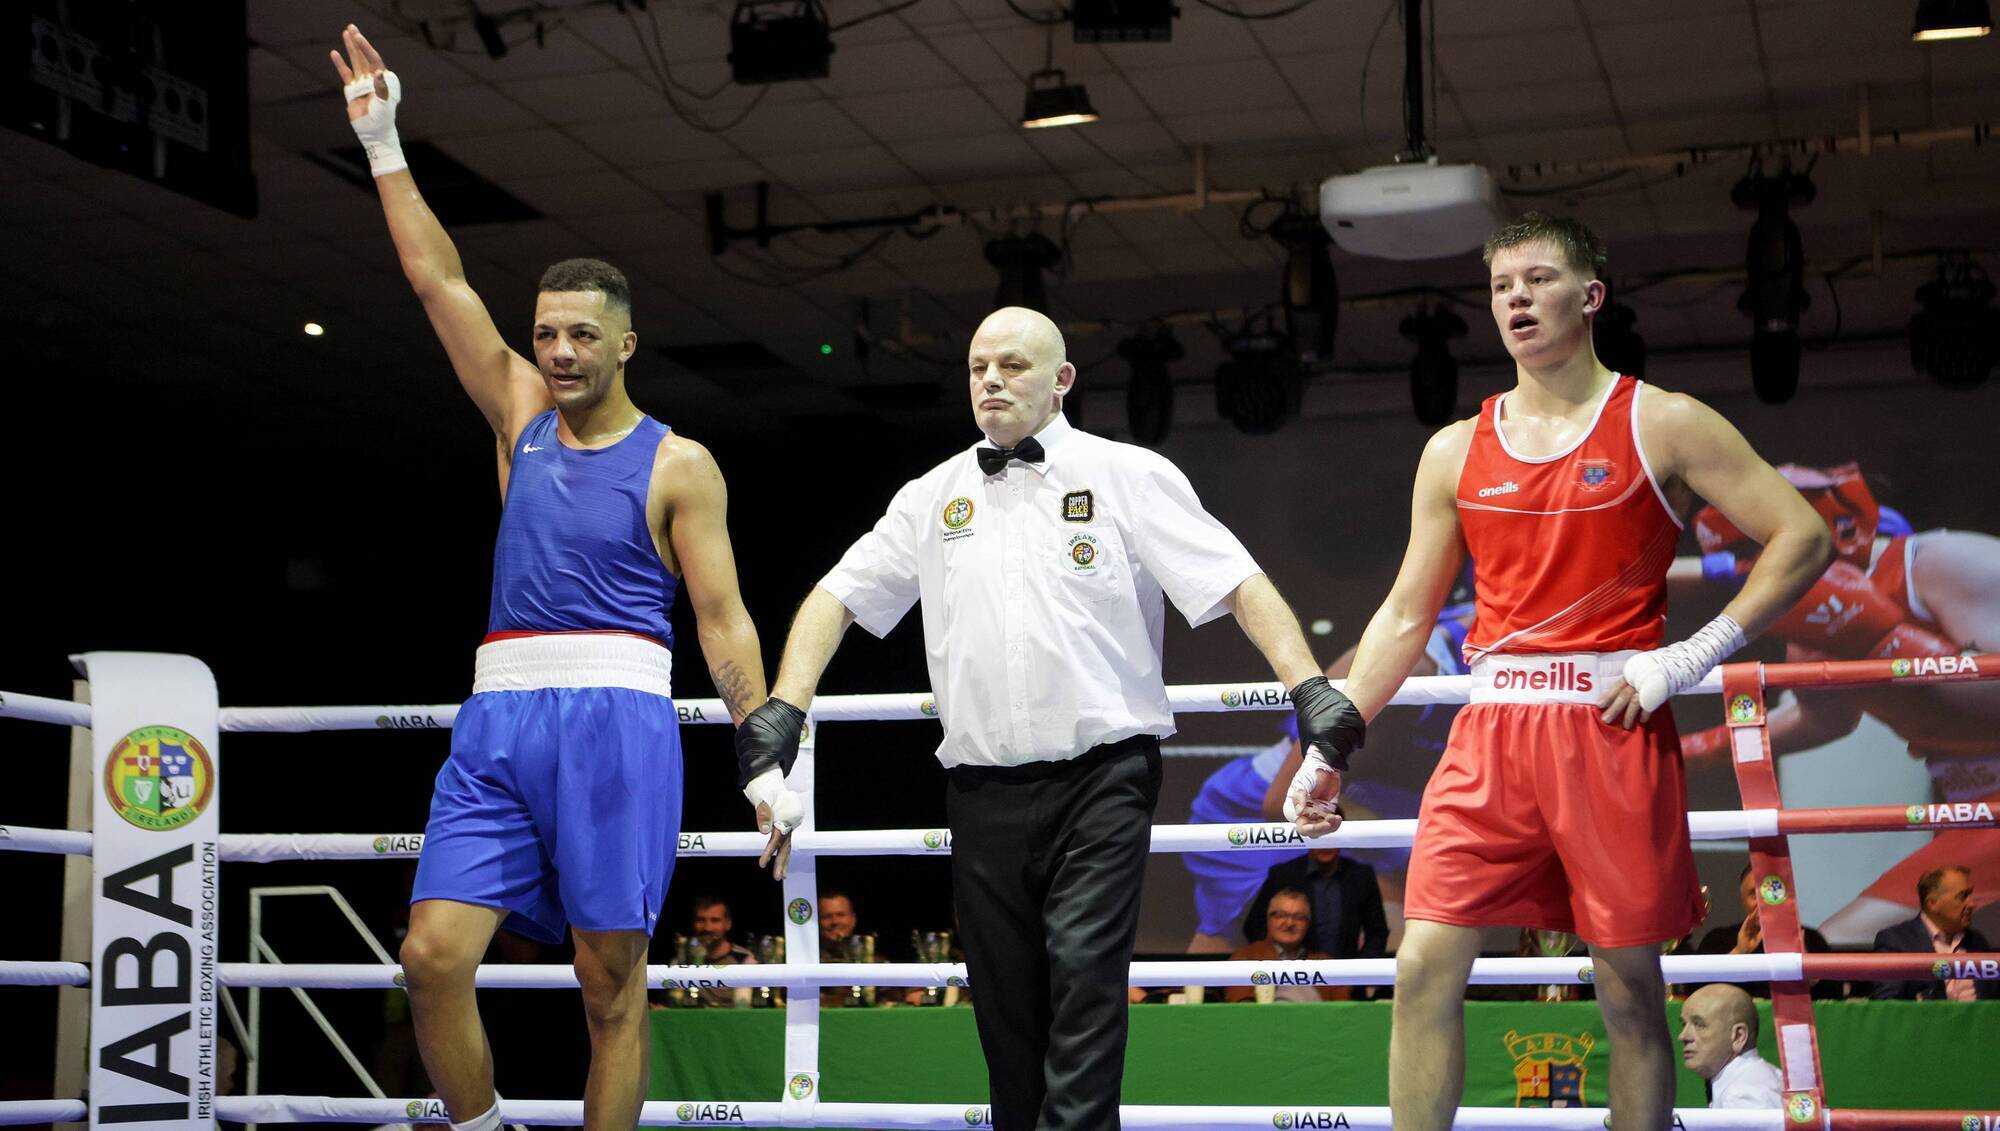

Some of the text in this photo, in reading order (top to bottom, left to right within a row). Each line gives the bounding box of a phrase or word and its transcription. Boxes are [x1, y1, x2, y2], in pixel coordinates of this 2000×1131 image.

[1913, 655, 1979, 676] IABA
[391, 715, 442, 729] IABA
[677, 706, 707, 722] BA
[1928, 801, 1995, 823] IABA
[390, 836, 422, 851] IAB
[678, 834, 706, 850] BA
[1249, 826, 1306, 845] IABA
[1272, 971, 1328, 986] IABA
[1953, 959, 2000, 980] IAB
[97, 842, 195, 1125] IABA
[197, 842, 215, 1120] IRISH ATHLETIC BOXING ASSOCIATION
[695, 1104, 745, 1122] IABA
[1295, 1112, 1351, 1131] IABA
